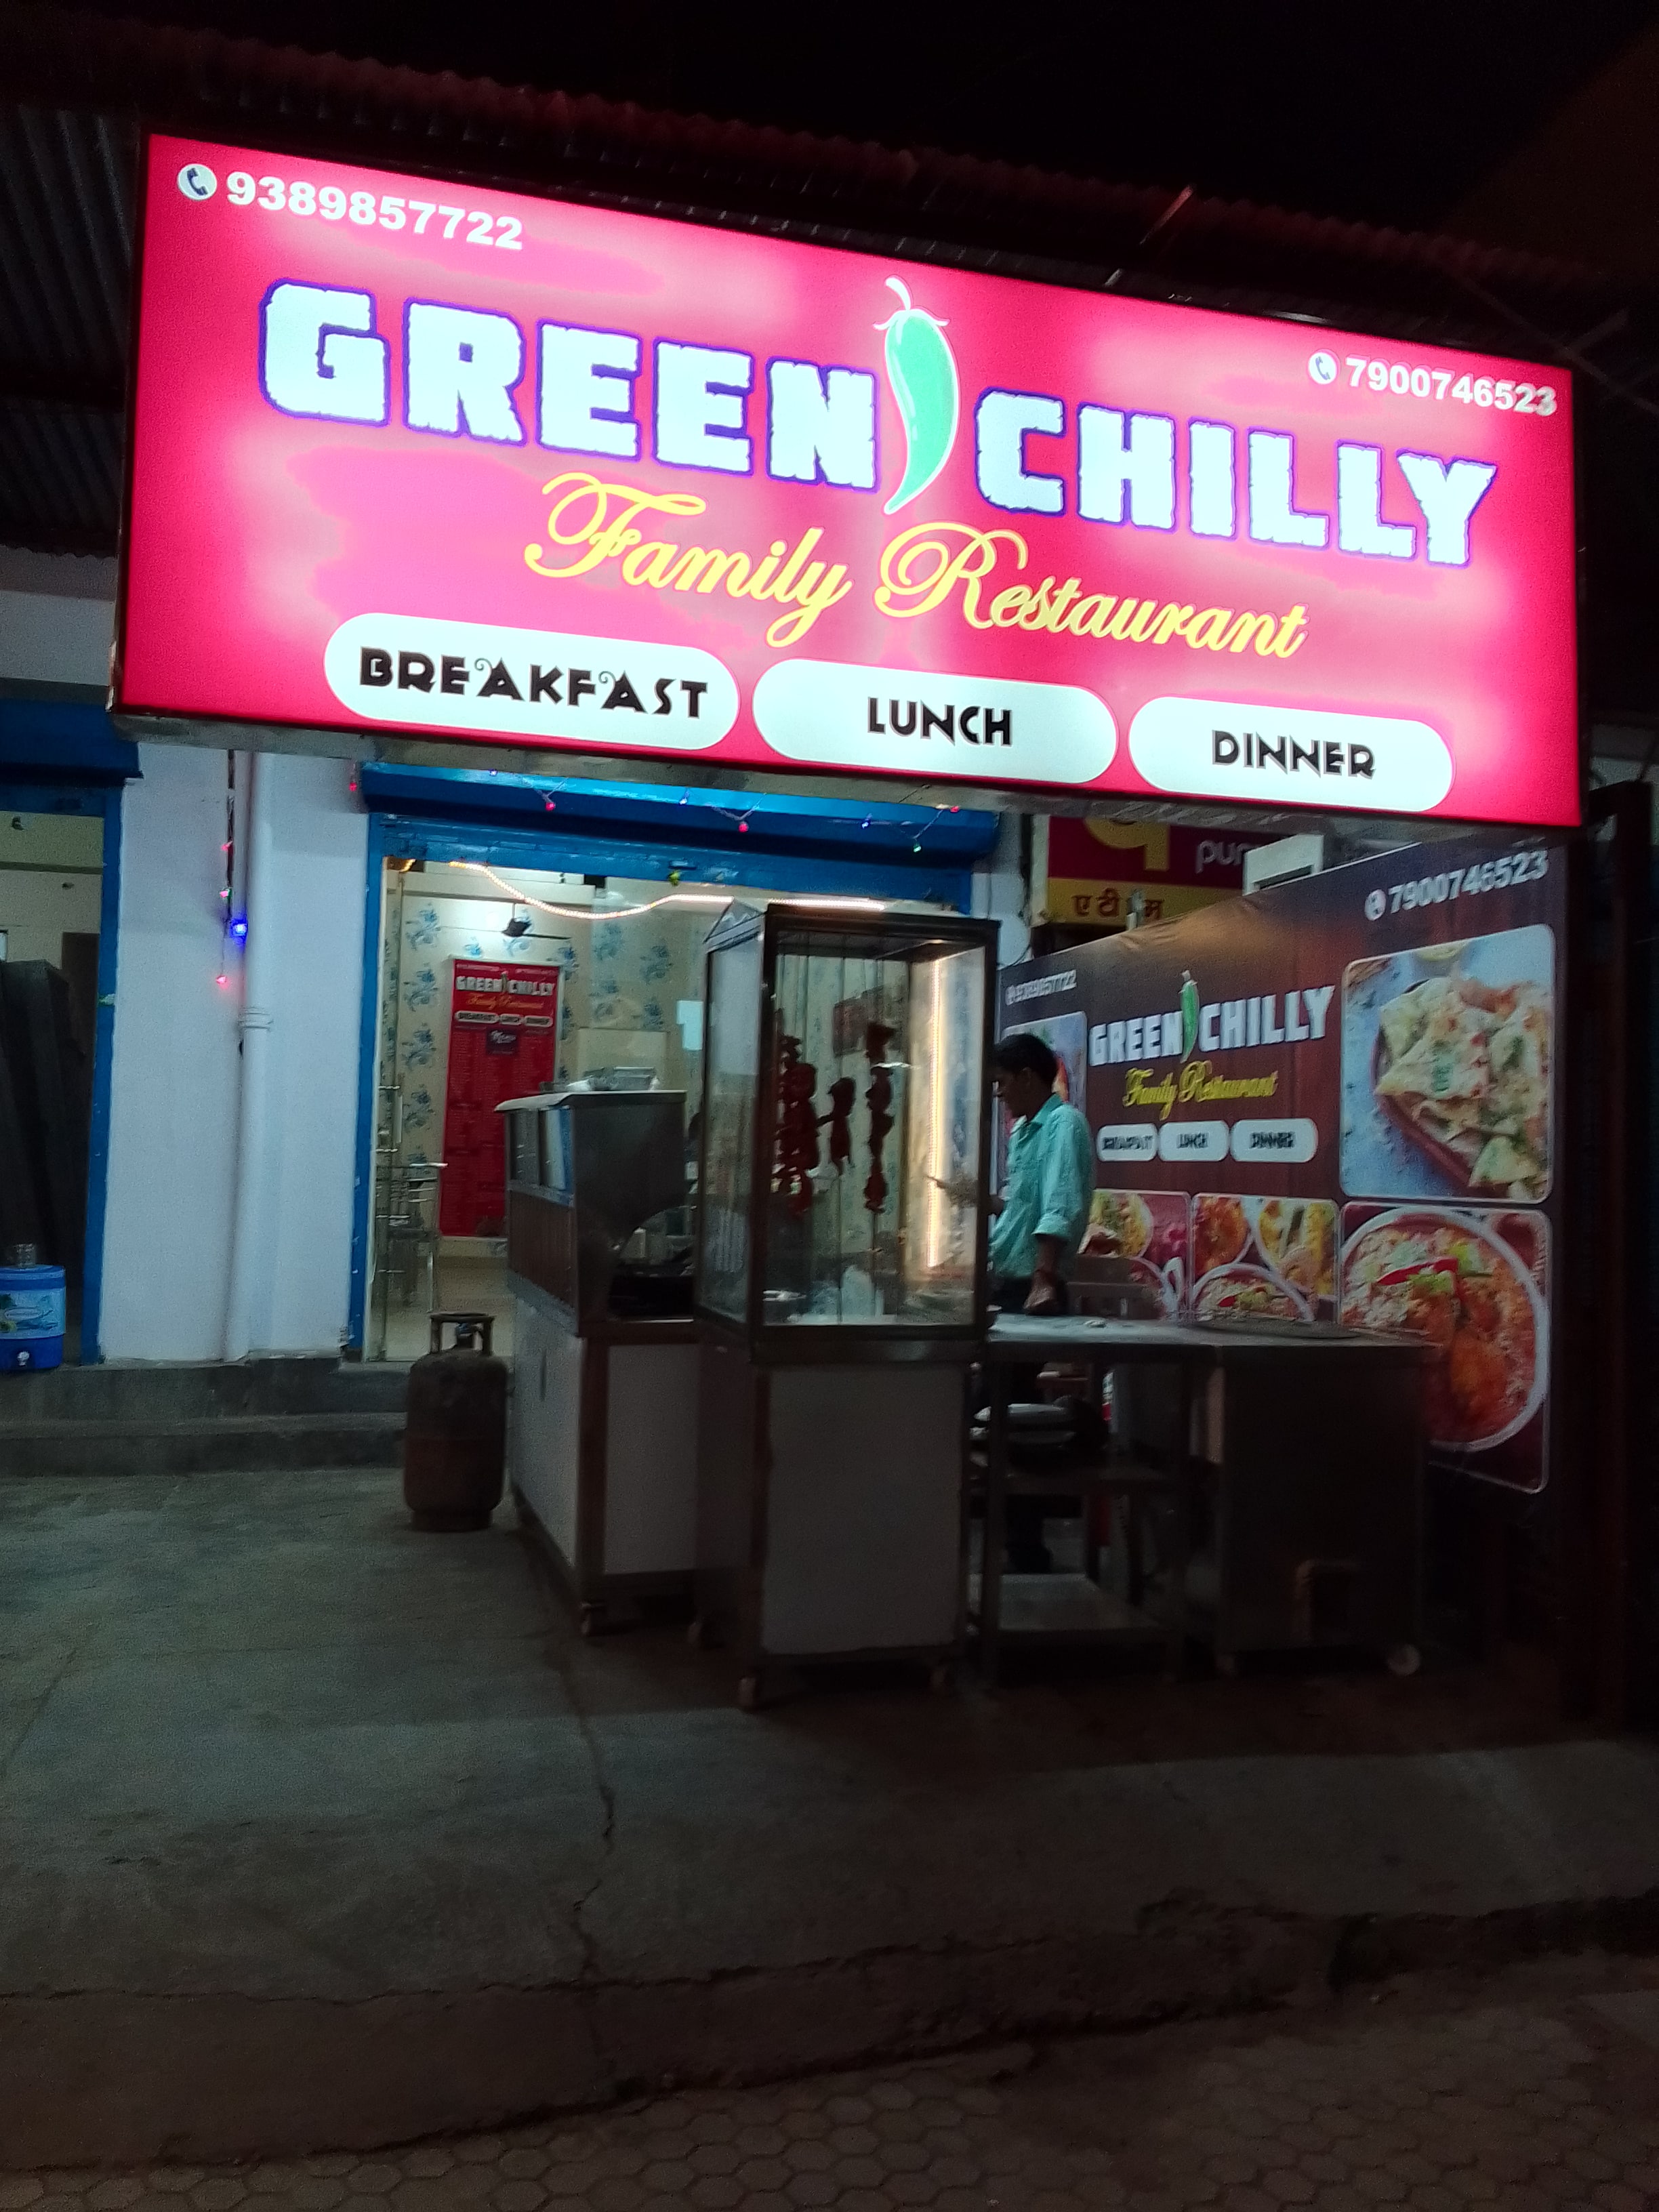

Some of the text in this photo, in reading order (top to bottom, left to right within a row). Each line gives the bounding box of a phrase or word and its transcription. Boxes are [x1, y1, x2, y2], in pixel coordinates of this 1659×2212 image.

[226, 171, 523, 251] 9389857722
[258, 276, 1498, 567] GREEN CHILLY
[1345, 356, 1558, 417] 7900746523
[524, 472, 1310, 658] Family Restaurant
[359, 646, 1376, 781] BREAKFAST LUNCH DINNER
[1088, 985, 1335, 1067] GREEN CHILLY
